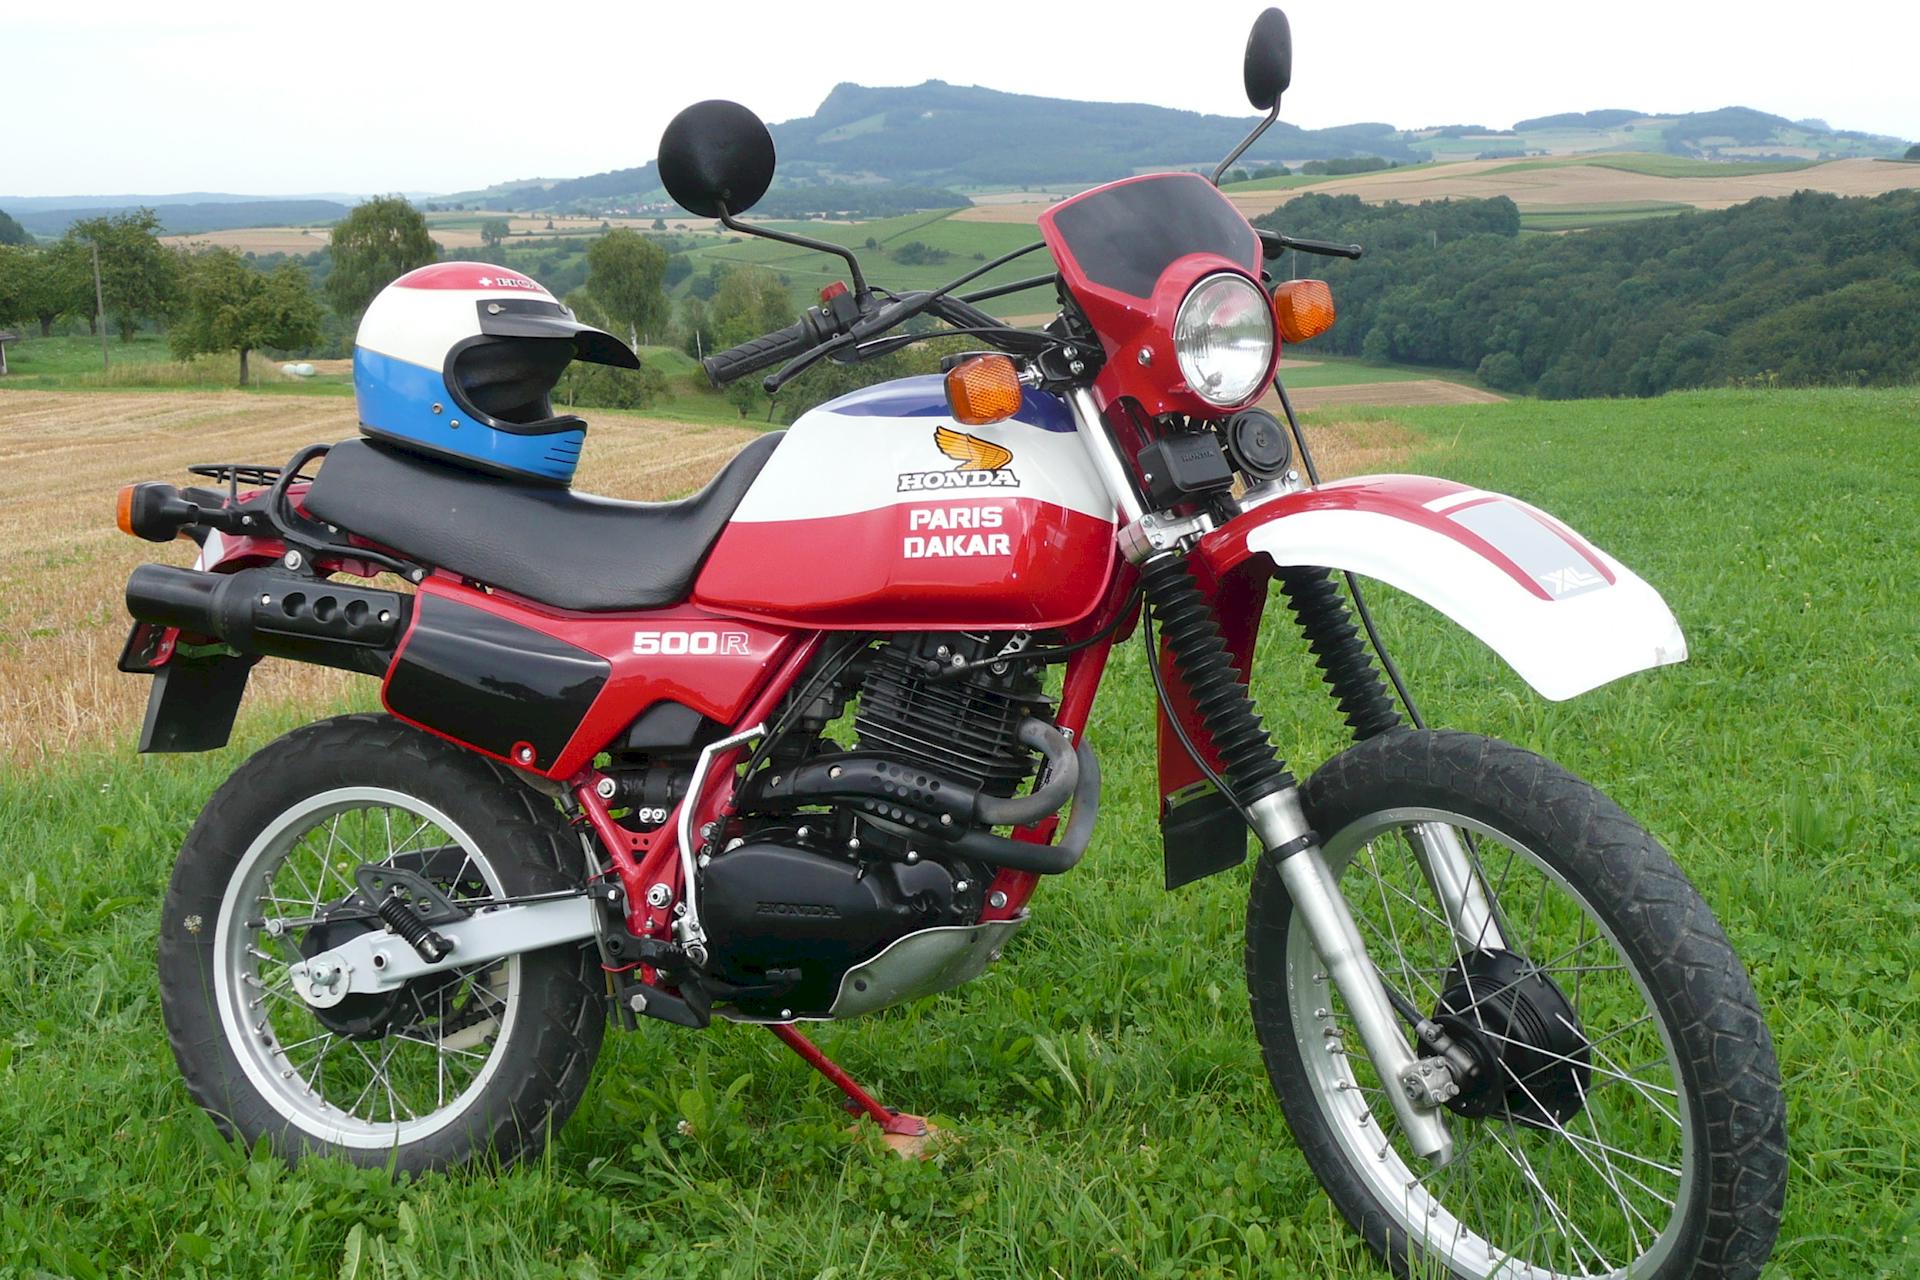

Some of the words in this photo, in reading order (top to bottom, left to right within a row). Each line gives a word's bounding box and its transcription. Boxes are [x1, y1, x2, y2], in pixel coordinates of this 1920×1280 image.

[897, 468, 1020, 492] HONDA
[909, 506, 1004, 531] PARIS
[903, 533, 1011, 559] DAKAR
[1540, 565, 1604, 594] XL
[756, 901, 842, 919] HONDA
